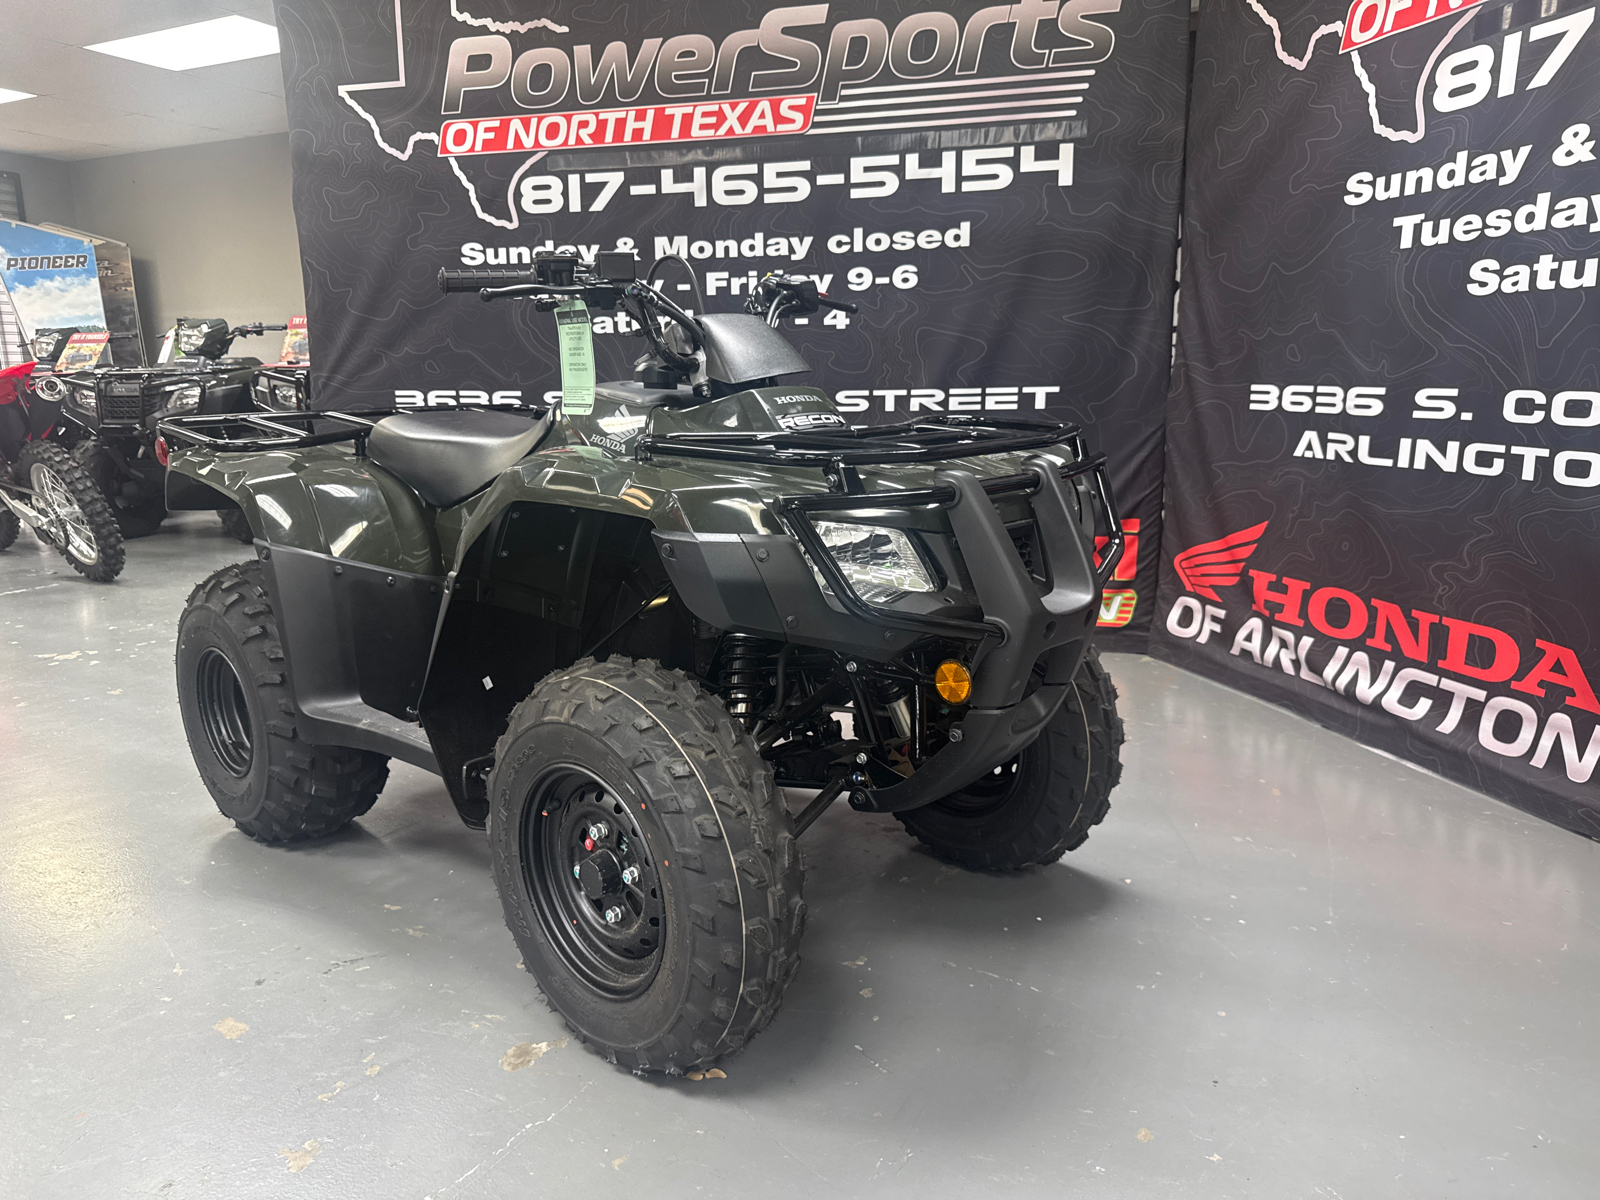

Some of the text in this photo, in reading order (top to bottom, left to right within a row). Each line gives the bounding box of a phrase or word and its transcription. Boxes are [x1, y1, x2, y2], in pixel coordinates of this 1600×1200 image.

[1350, 0, 1413, 43] OF
[441, 0, 1123, 115] PowerSports
[445, 98, 808, 153] OF NORTH TEXAS
[520, 143, 1074, 214] 817-465-5454
[1344, 123, 1596, 206] Sunday &
[7, 254, 88, 271] PIONEER
[614, 237, 641, 261] &
[654, 232, 813, 262] Monday
[827, 221, 971, 253] closed
[706, 269, 834, 296] Friy
[847, 264, 919, 292] 9-6
[1467, 254, 1599, 296] Satu
[823, 309, 850, 330] 4
[394, 390, 522, 408] 3636
[835, 386, 1060, 412] STREET
[774, 395, 823, 405] HONDA
[1249, 384, 1600, 427] 3636 S. CO
[777, 415, 846, 429] RECON
[590, 434, 626, 454] HONDA
[1293, 430, 1600, 488] ARLINGTO
[1249, 569, 1600, 716] HONDA
[1167, 596, 1600, 784] OF ARLINGTON
